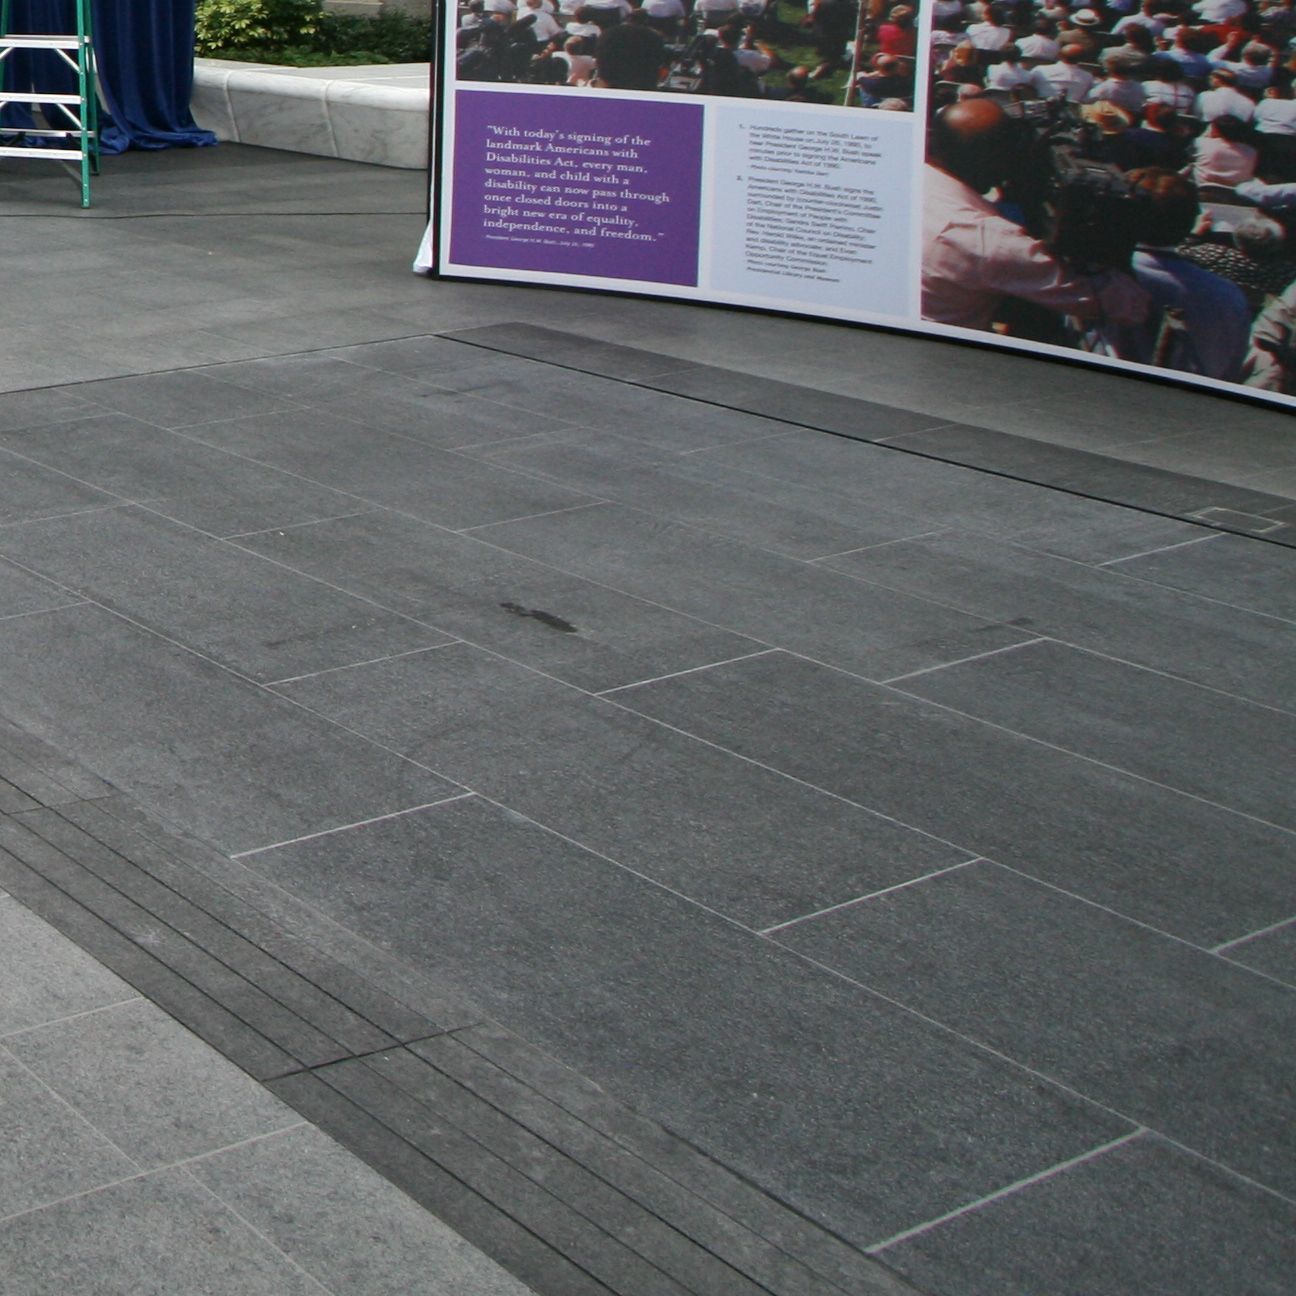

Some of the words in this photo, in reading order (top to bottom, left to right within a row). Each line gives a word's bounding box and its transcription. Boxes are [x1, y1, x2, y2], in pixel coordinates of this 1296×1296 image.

[566, 131, 612, 146] signing
[614, 134, 630, 144] of
[630, 135, 651, 146] the
[485, 138, 543, 152] landmark
[544, 142, 610, 156] Americans
[611, 148, 638, 159] with
[485, 151, 551, 165] Disabilities
[581, 161, 614, 173] every
[533, 169, 557, 179] and
[559, 170, 590, 182] child
[592, 173, 619, 184] with
[483, 177, 538, 194] disability
[539, 185, 561, 193] can
[564, 186, 590, 195] now
[591, 189, 617, 199] pass
[619, 188, 670, 205] through
[483, 193, 512, 202] once
[514, 193, 552, 206] closed
[553, 196, 589, 208] doors
[592, 201, 618, 211] into
[483, 203, 519, 218] bright
[522, 210, 546, 218] new
[547, 212, 568, 220] era
[569, 211, 585, 221] of
[573, 225, 597, 236] and
